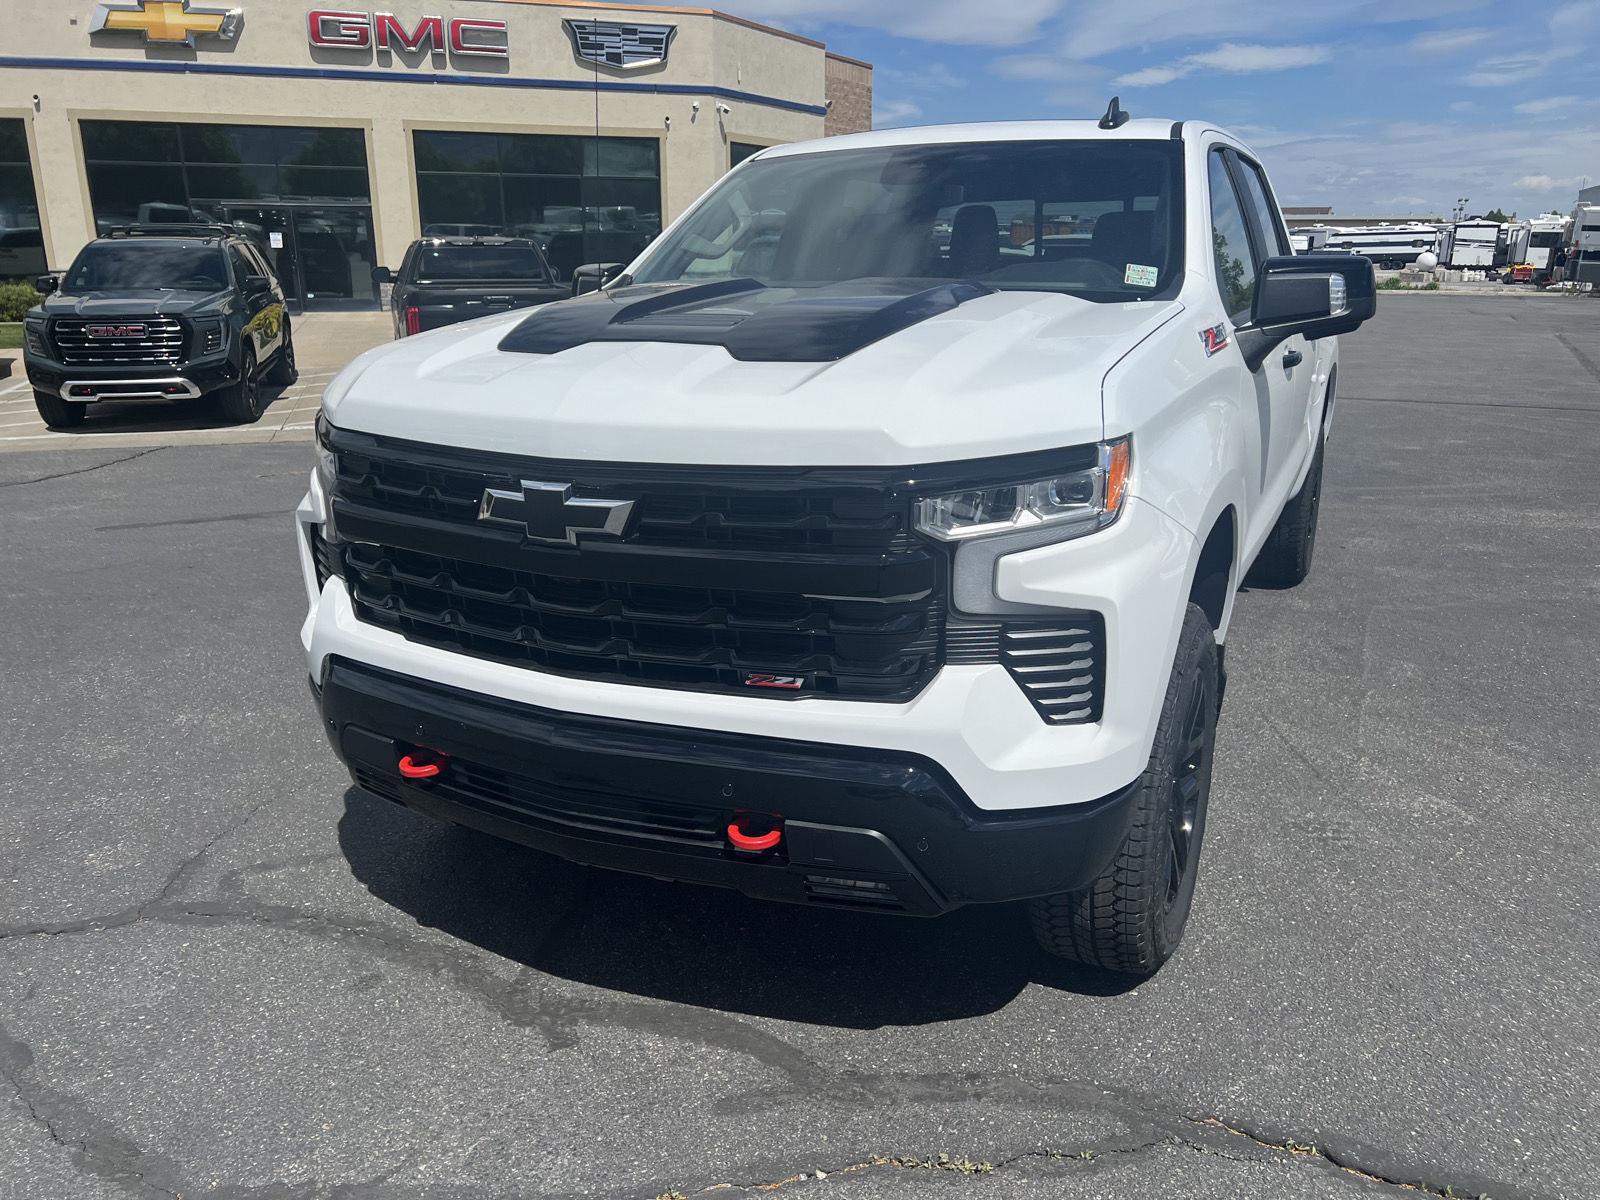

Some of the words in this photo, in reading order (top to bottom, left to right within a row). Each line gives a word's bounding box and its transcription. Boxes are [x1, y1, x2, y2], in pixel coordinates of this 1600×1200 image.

[308, 9, 509, 58] GMC
[89, 326, 145, 337] GMC
[745, 673, 804, 689] Z71
